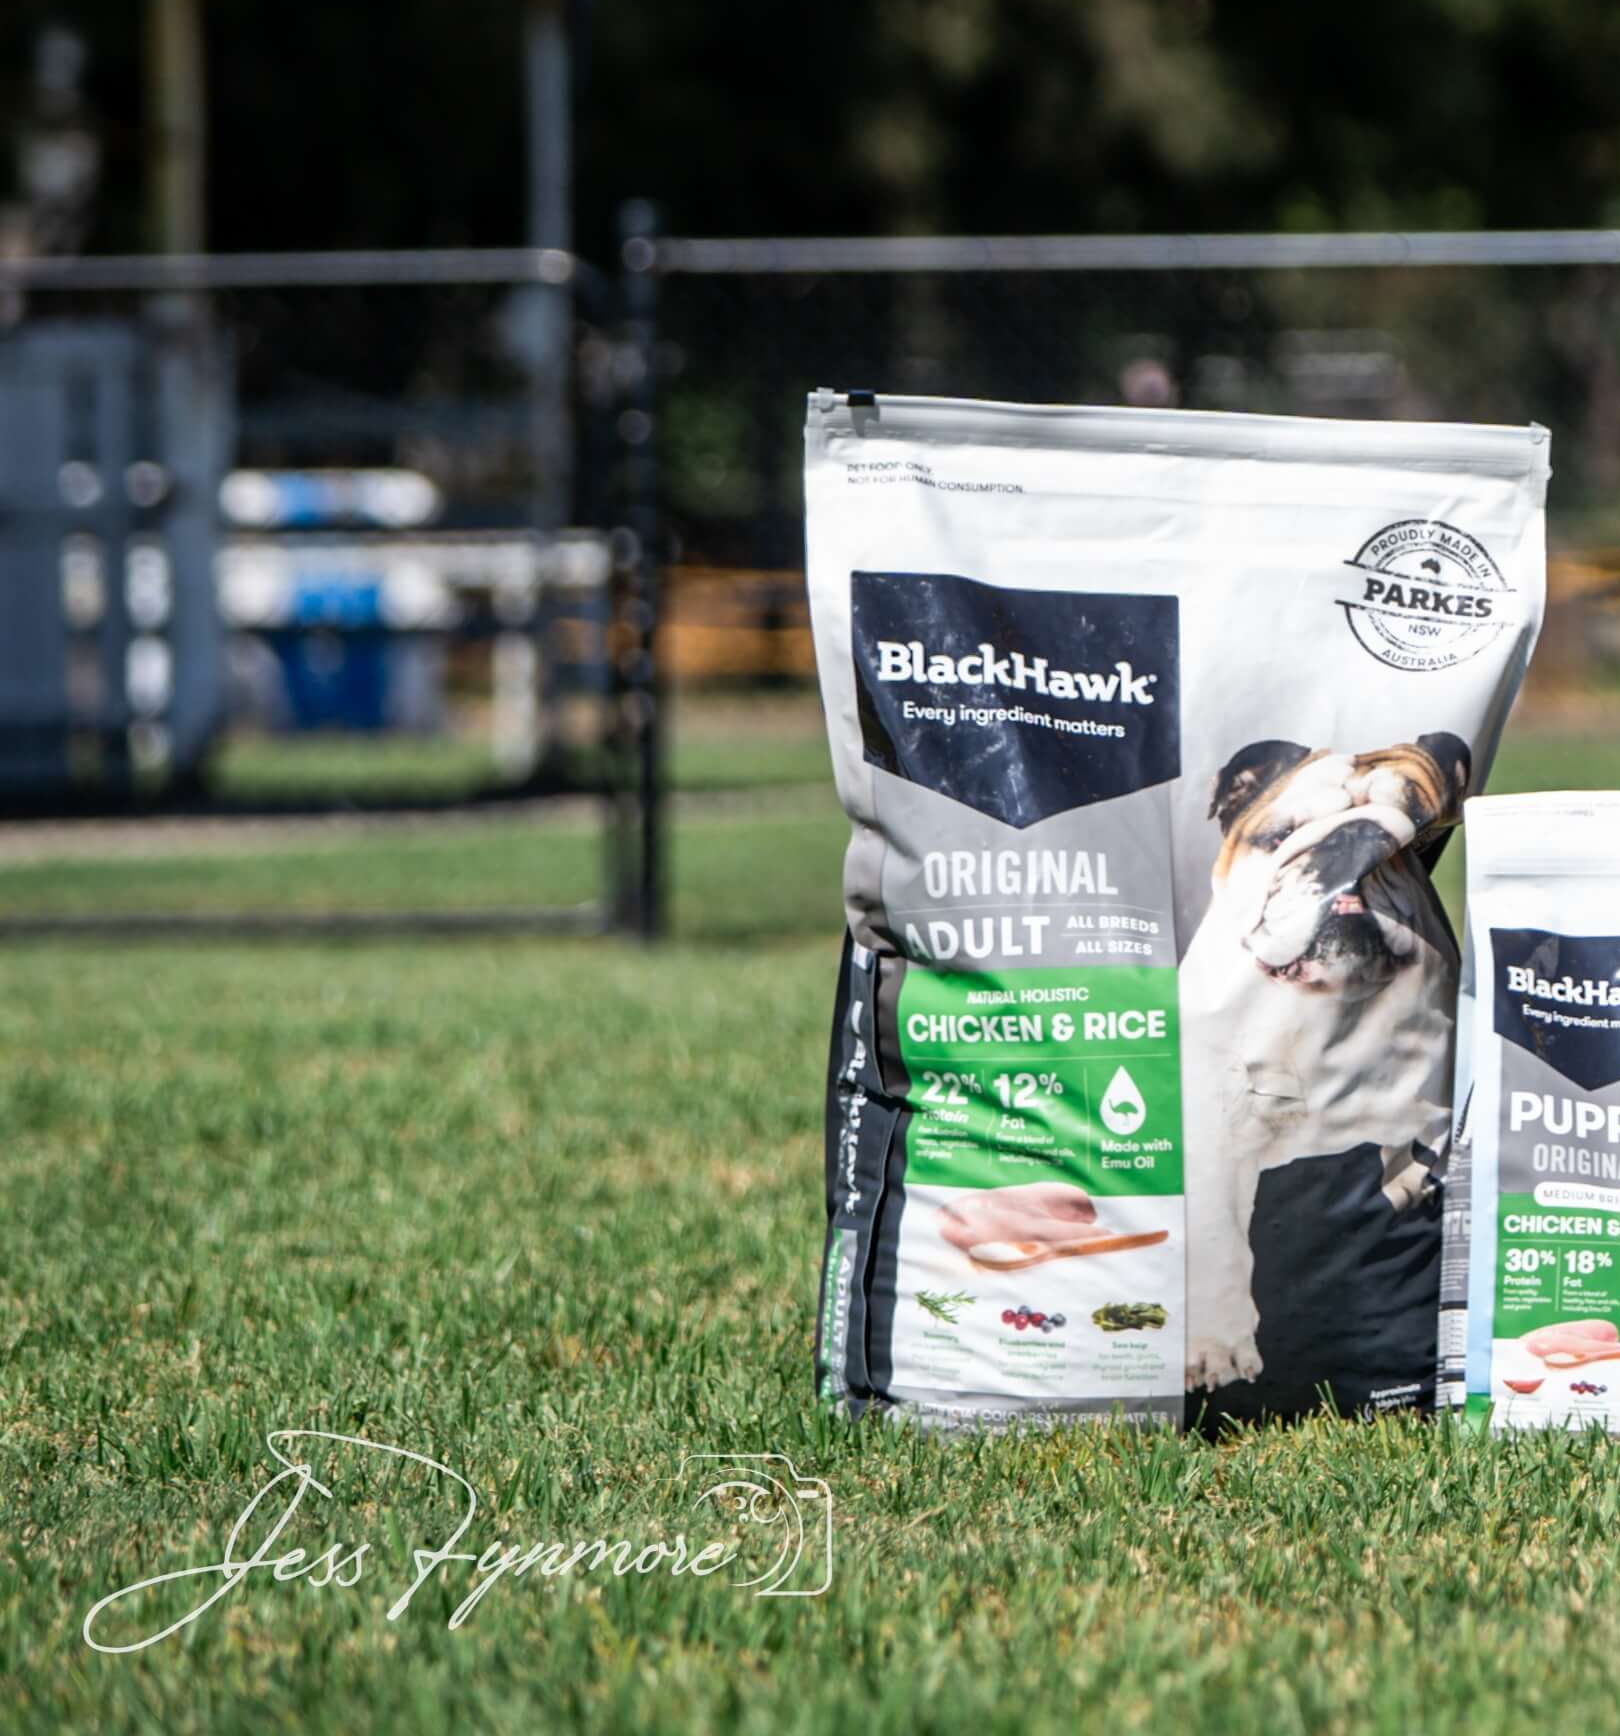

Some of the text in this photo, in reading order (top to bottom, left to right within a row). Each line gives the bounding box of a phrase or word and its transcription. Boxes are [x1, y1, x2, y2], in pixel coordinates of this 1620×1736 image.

[1370, 529, 1492, 578] PROUDLY MADE IN
[1363, 577, 1493, 618] PARKES
[1408, 624, 1442, 637] NSW
[1381, 648, 1459, 667] AUSTRALIA
[902, 700, 1126, 739] Every ingredient matters
[923, 850, 1119, 899] ORIGINAL
[1066, 915, 1160, 935] ALL BREEDS
[904, 915, 1051, 960] ADULT
[1075, 940, 1153, 956] ALL SIZES
[966, 987, 1090, 1005] NATURAL HOLISTIC
[906, 1009, 1167, 1043] CHICKEN & RICE
[1521, 1003, 1553, 1024] Every
[1552, 1010, 1609, 1029] ingredient
[1101, 1137, 1173, 1153] Made with
[1101, 1155, 1155, 1170] Emu Oil
[1543, 1189, 1595, 1202] MEDIUM
[1503, 1214, 1603, 1236] CHICKEN
[1503, 1275, 1583, 1288] Protein Fat
